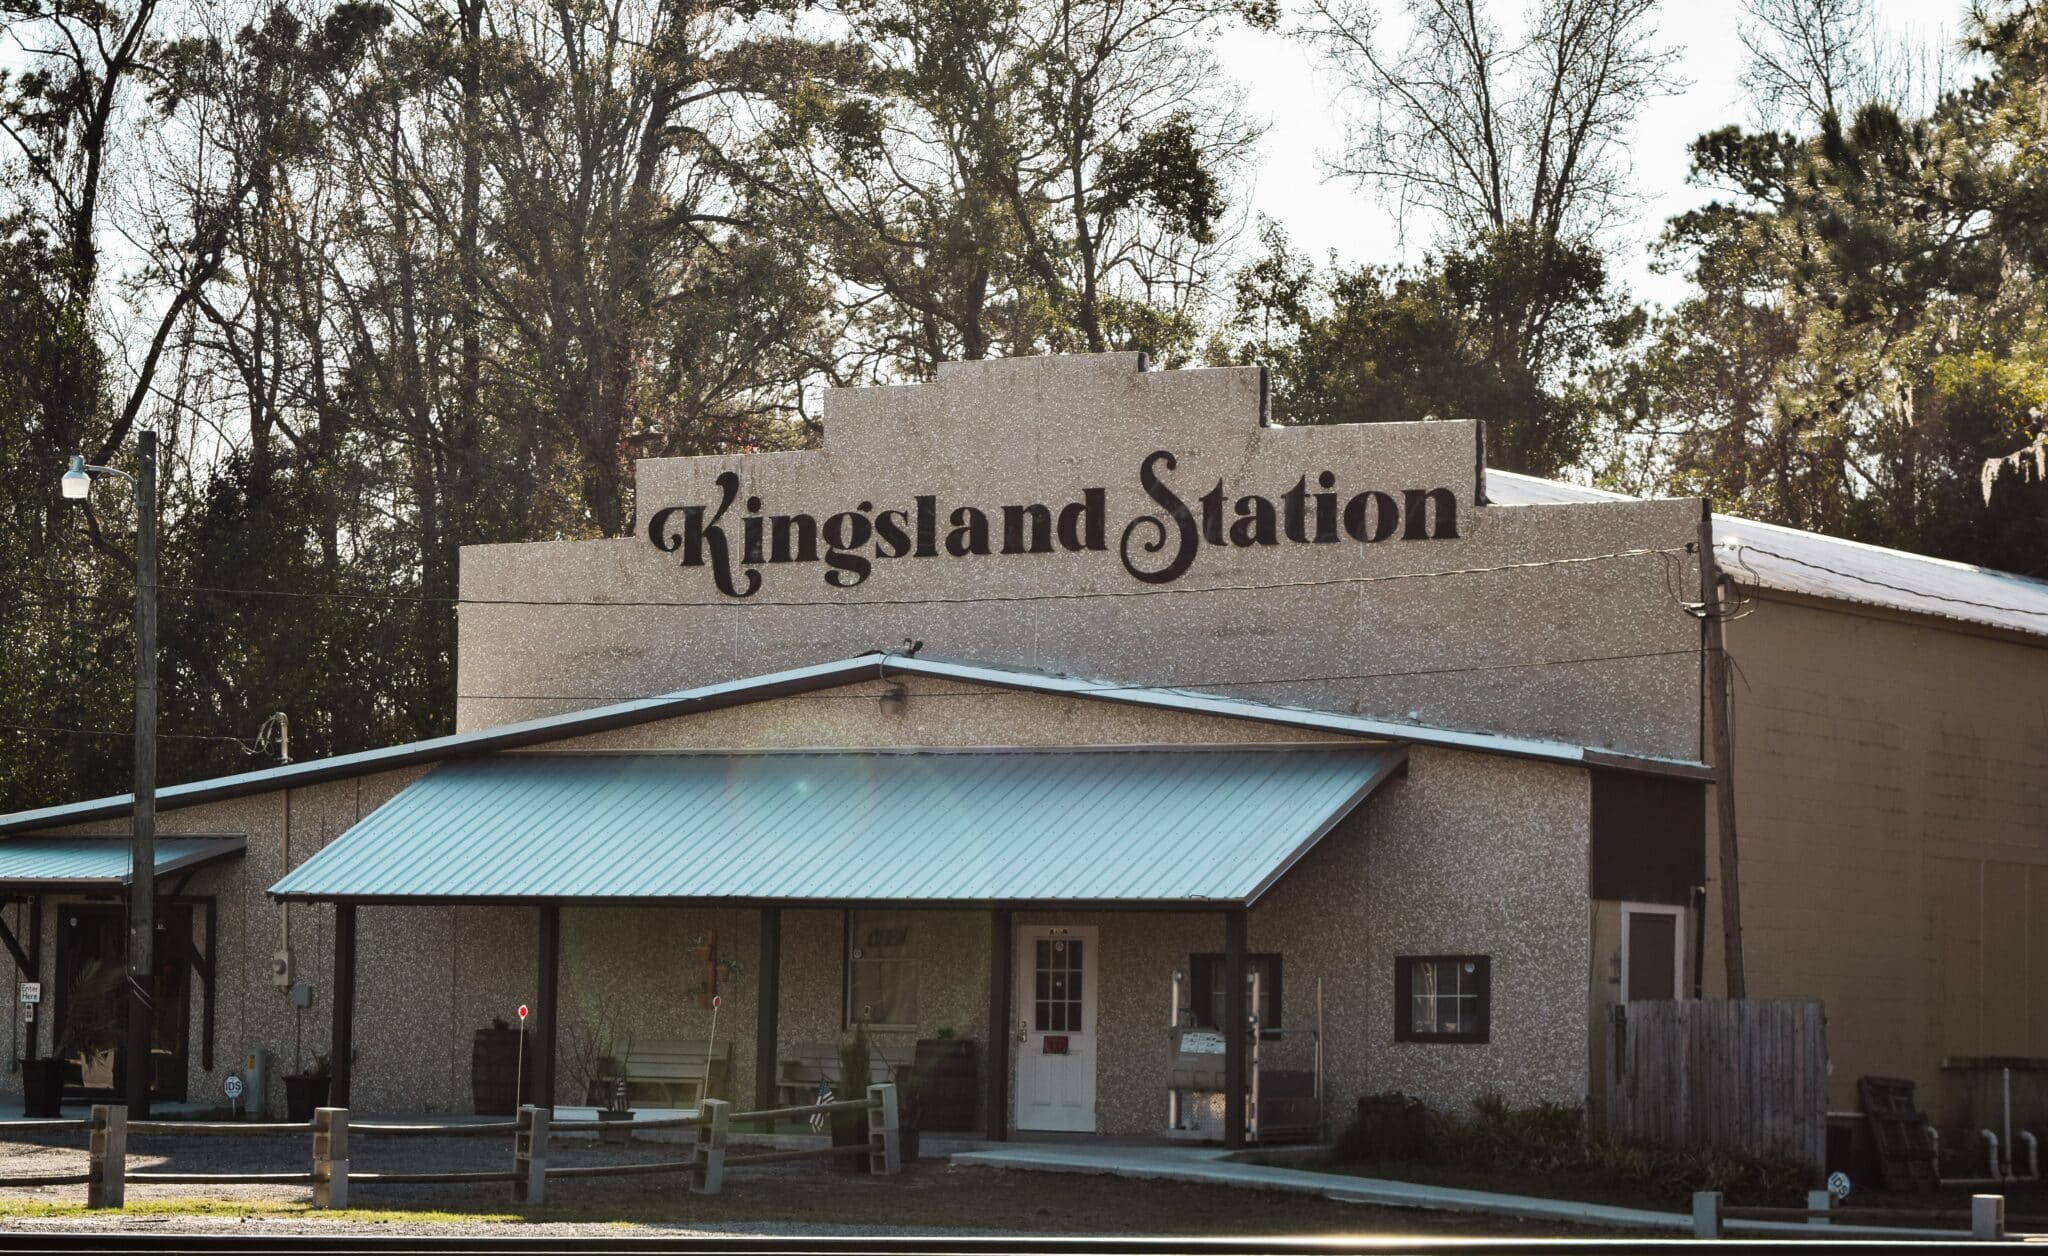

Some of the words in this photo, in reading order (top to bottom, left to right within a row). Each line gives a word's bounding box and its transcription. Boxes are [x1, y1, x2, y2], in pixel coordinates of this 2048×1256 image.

[648, 471, 1109, 598] Kingsland
[1119, 450, 1461, 585] Station
[22, 984, 38, 992] Enter
[225, 1081, 241, 1091] IDS
[1830, 1174, 1848, 1195] IDS
